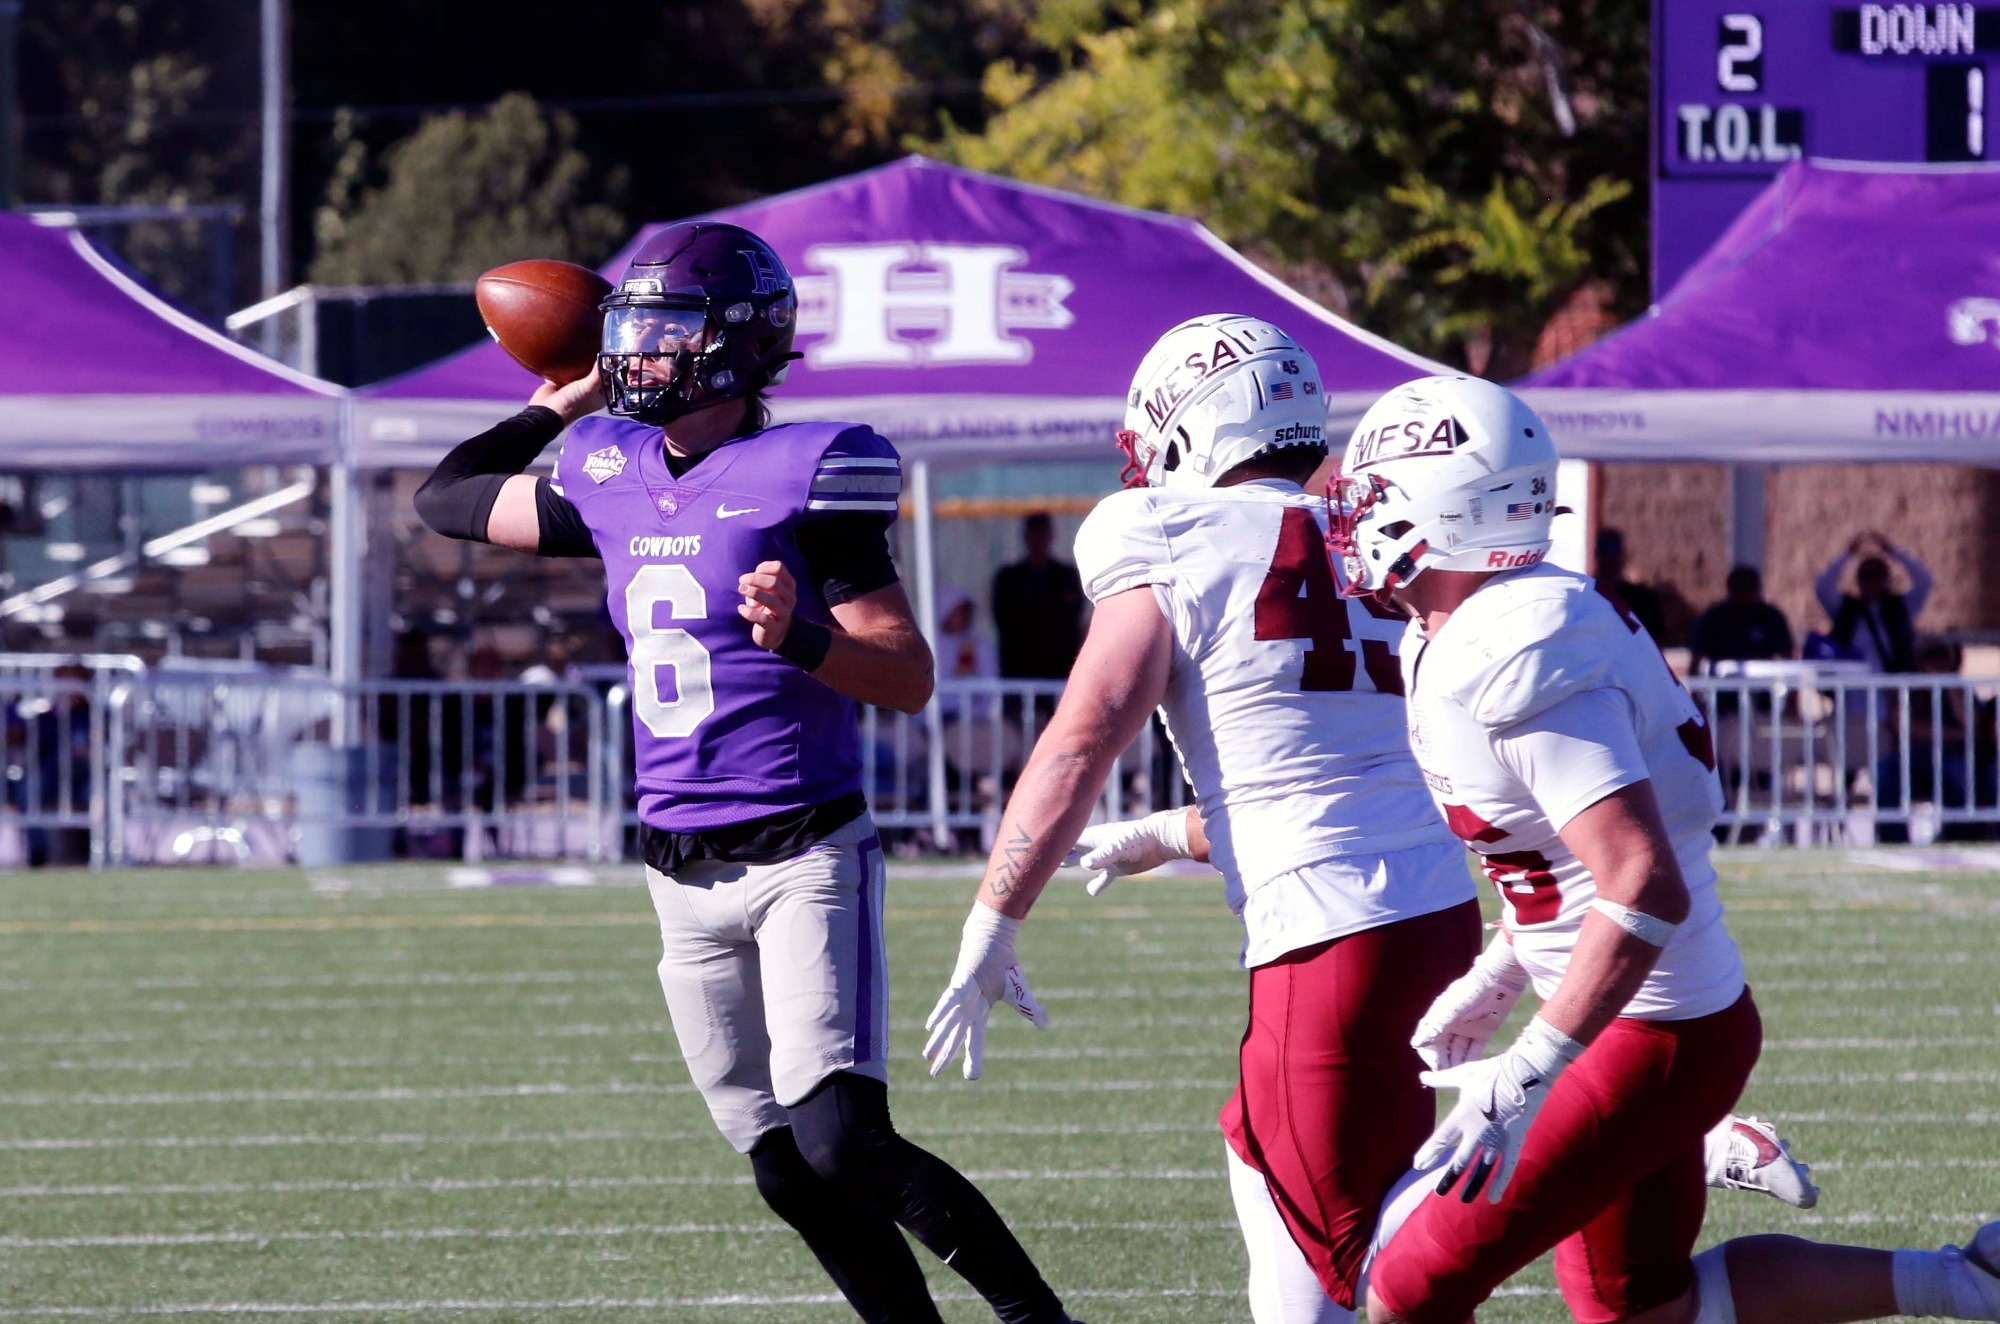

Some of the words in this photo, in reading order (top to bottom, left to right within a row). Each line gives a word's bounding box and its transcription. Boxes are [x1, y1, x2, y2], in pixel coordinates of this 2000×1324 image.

[1860, 2, 1975, 55] DOWN
[1717, 13, 1762, 92] 2
[803, 240, 1034, 371] H
[1282, 360, 1300, 375] 45
[1143, 338, 1238, 430] MESA
[1303, 381, 1318, 395] CH
[1273, 422, 1322, 443] schutt
[1537, 410, 1646, 431] OWBOYS
[585, 455, 625, 472] RMAC
[629, 534, 702, 558] COWBOYS
[625, 564, 715, 738] 6
